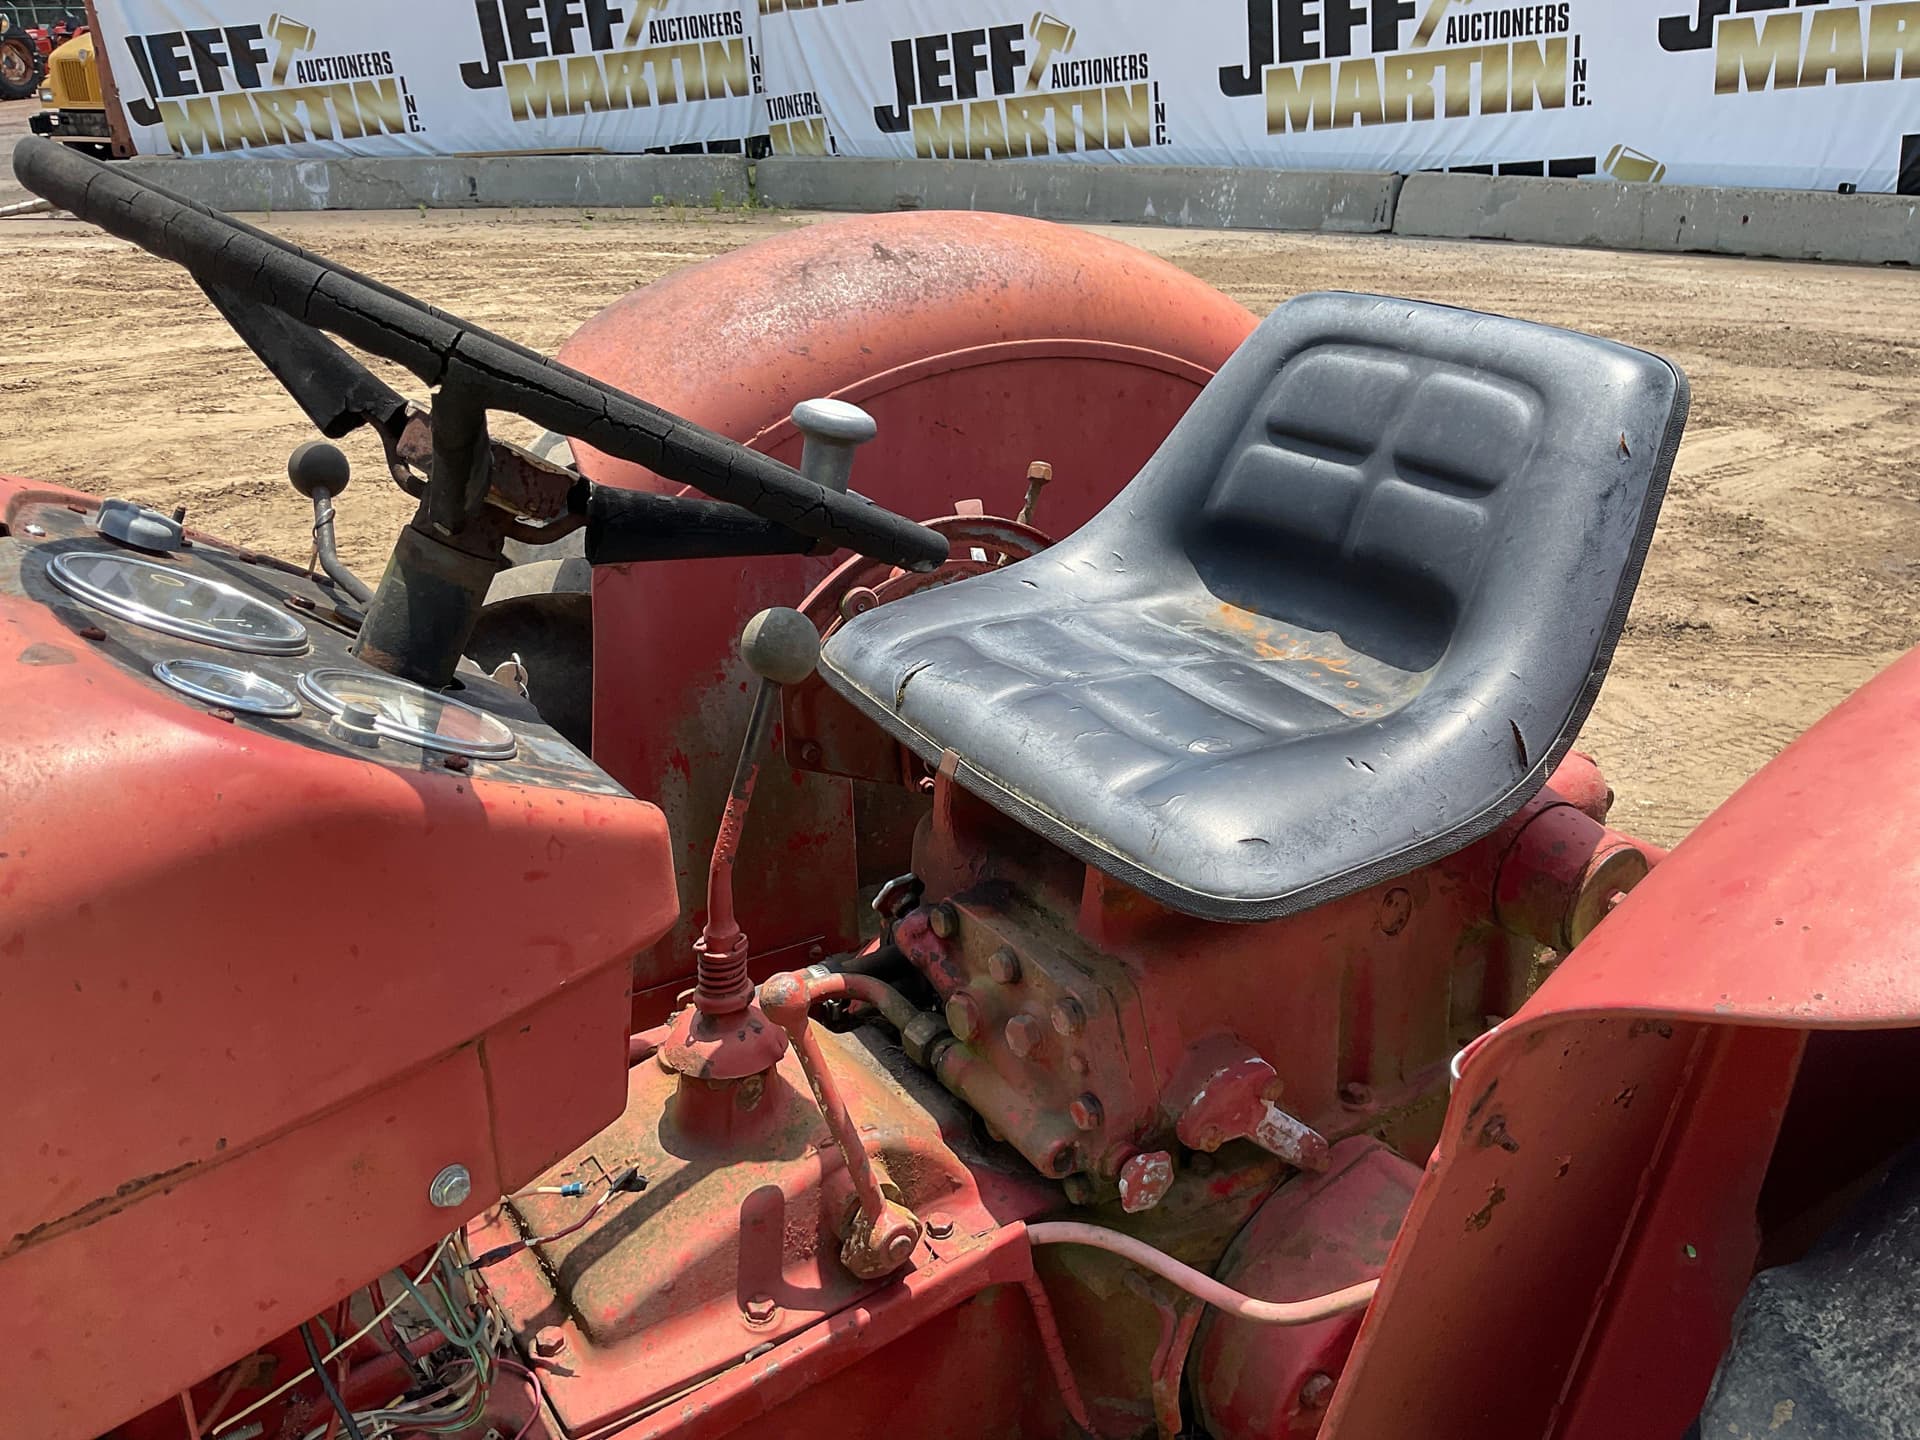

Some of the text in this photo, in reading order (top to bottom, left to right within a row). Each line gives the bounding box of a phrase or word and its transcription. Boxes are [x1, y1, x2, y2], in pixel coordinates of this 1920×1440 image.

[460, 0, 624, 89] JEFF
[649, 10, 742, 44] AUCTIONEERS
[1219, 0, 1415, 97] JEFF
[1446, 3, 1569, 45] AUCTIONEERS
[1714, 2, 1920, 95] MAR
[125, 24, 268, 127] JEFF
[297, 51, 394, 84] AUCTIONEERS
[502, 38, 749, 122] MARTIN
[766, 92, 822, 122] TIONEERS
[874, 24, 1026, 134] JEFF
[1051, 53, 1149, 89] AUCTIONEERS
[1266, 37, 1568, 136] MARTIN
[159, 78, 405, 155] MARTIN
[912, 84, 1151, 160] MARTIN
